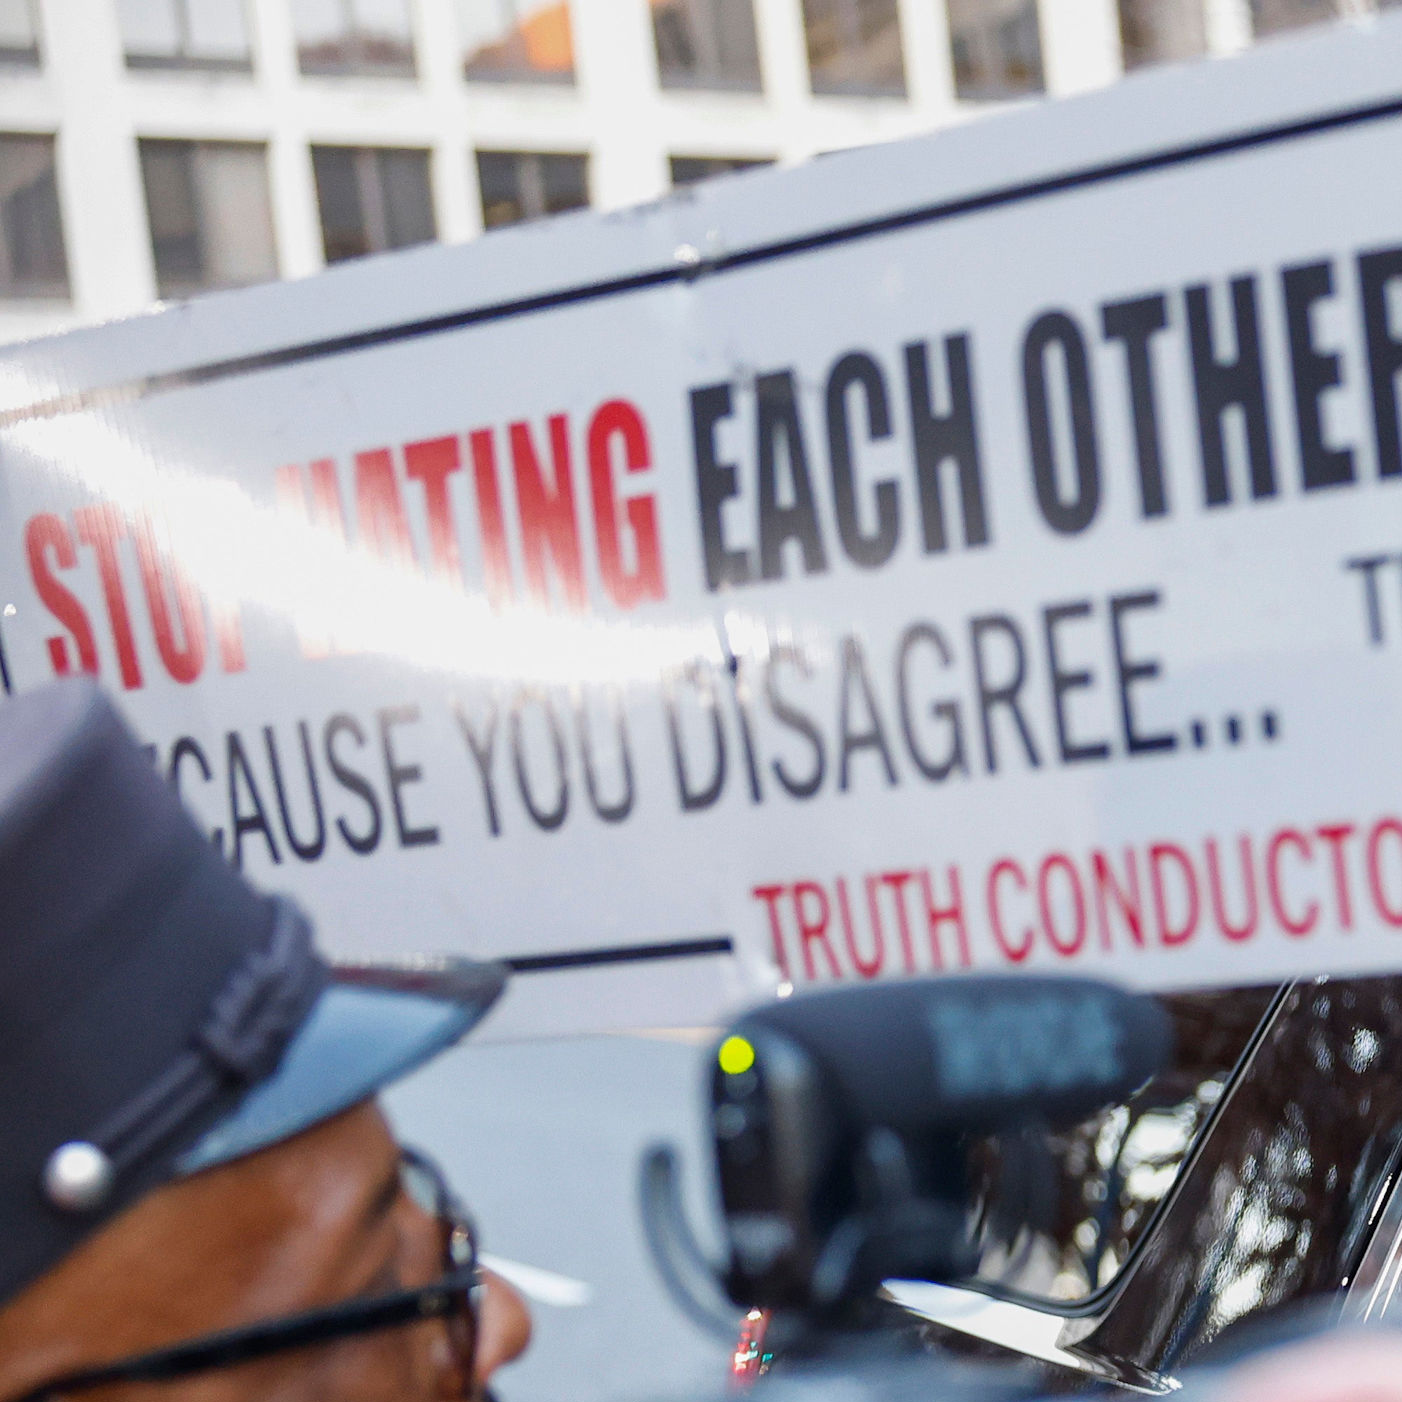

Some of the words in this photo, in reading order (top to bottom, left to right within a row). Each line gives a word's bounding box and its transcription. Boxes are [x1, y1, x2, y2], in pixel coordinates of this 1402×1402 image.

[686, 331, 993, 592] EACH
[140, 705, 441, 869] CAUSE
[452, 682, 637, 839] YOU
[663, 591, 1279, 815] DISAGREE...
[753, 864, 972, 982] TRUTH
